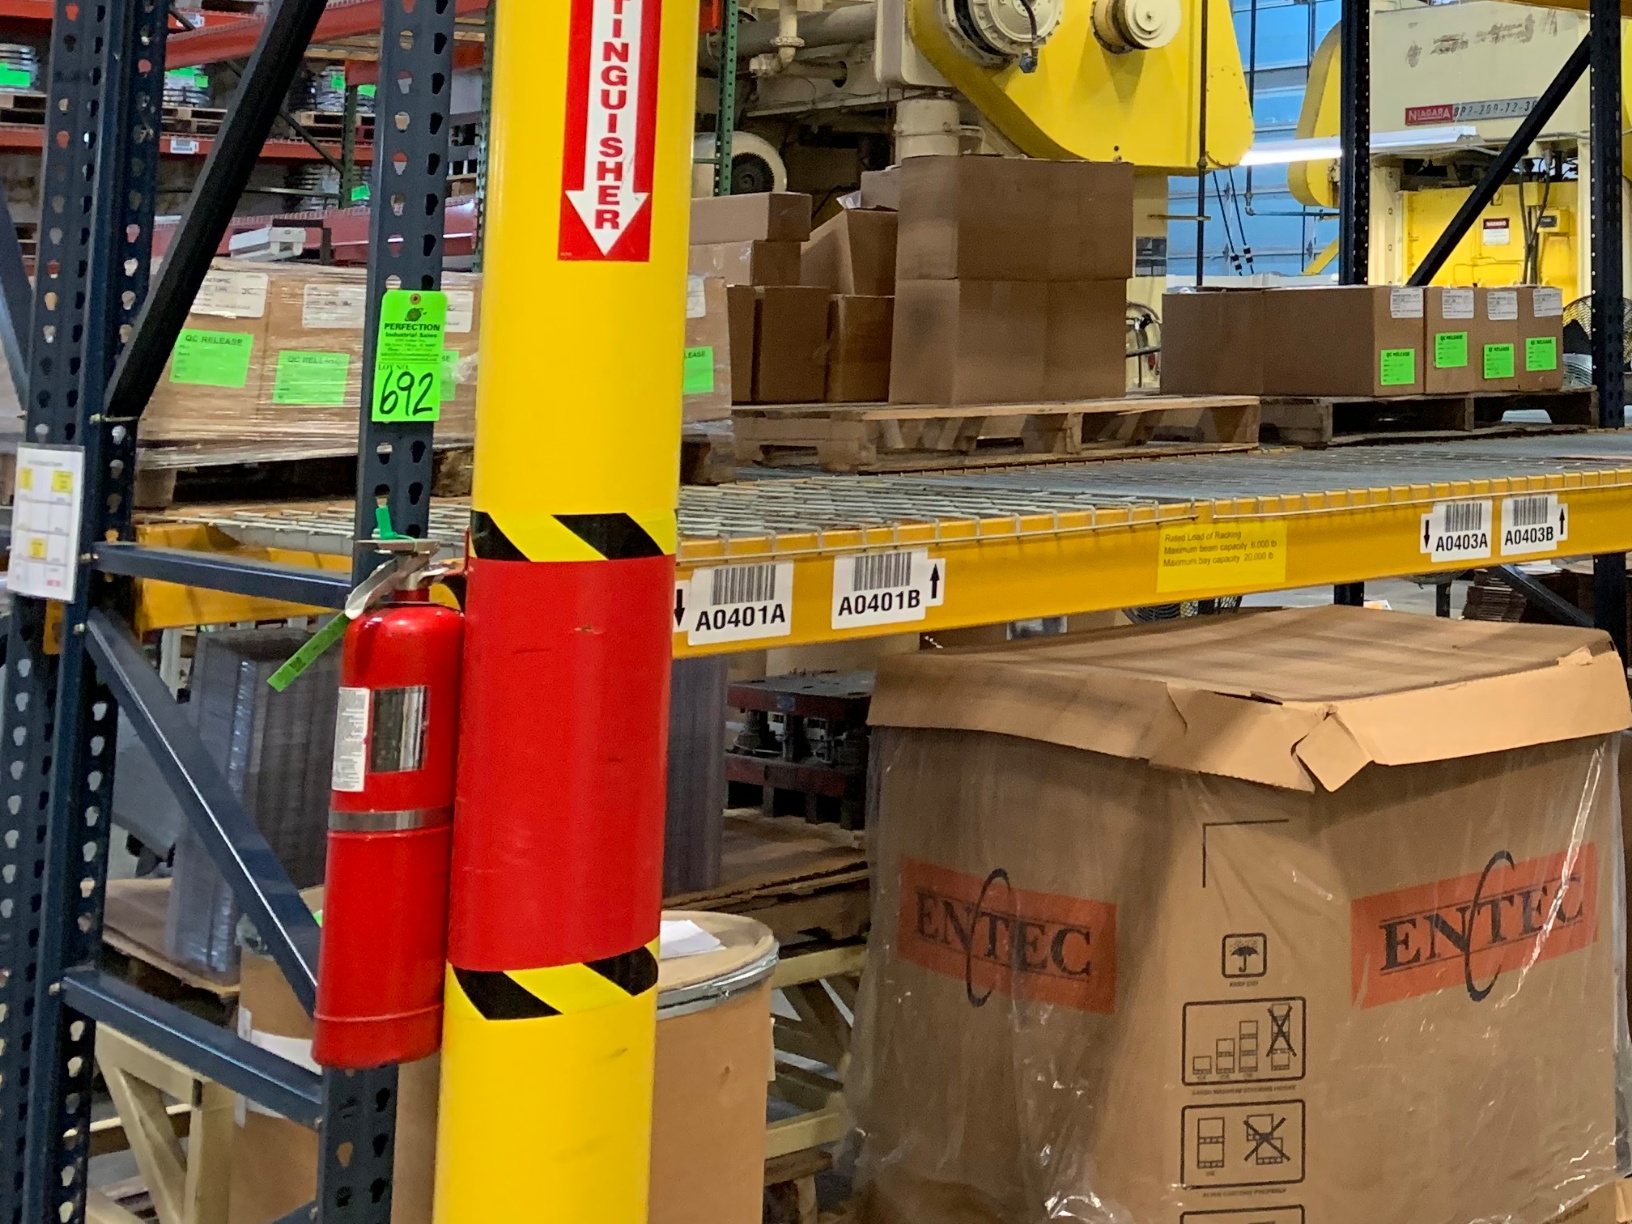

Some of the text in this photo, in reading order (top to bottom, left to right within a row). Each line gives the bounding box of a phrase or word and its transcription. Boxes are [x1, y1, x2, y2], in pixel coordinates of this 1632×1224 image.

[1408, 107, 1451, 121] NIAGARA
[384, 323, 440, 331] PERFECTION
[185, 334, 243, 347] QC RELEASE
[287, 355, 300, 363] QC
[684, 350, 706, 359] LEASE
[379, 368, 434, 417] 692
[1165, 531, 1242, 542] Rated Load of Racking
[1435, 533, 1488, 552] A0403A
[1504, 526, 1554, 546] A0403B
[1164, 546, 1198, 555] Maximum
[1200, 544, 1218, 552] beam
[1220, 542, 1248, 552] capacity
[1163, 558, 1197, 567] Maximum
[1198, 556, 1211, 566] bay
[1212, 554, 1240, 564] capacity
[838, 589, 921, 616] A0401B
[695, 603, 786, 632] A0401A
[1379, 866, 1583, 986] ENTEC
[916, 880, 1091, 988] ENTEC
